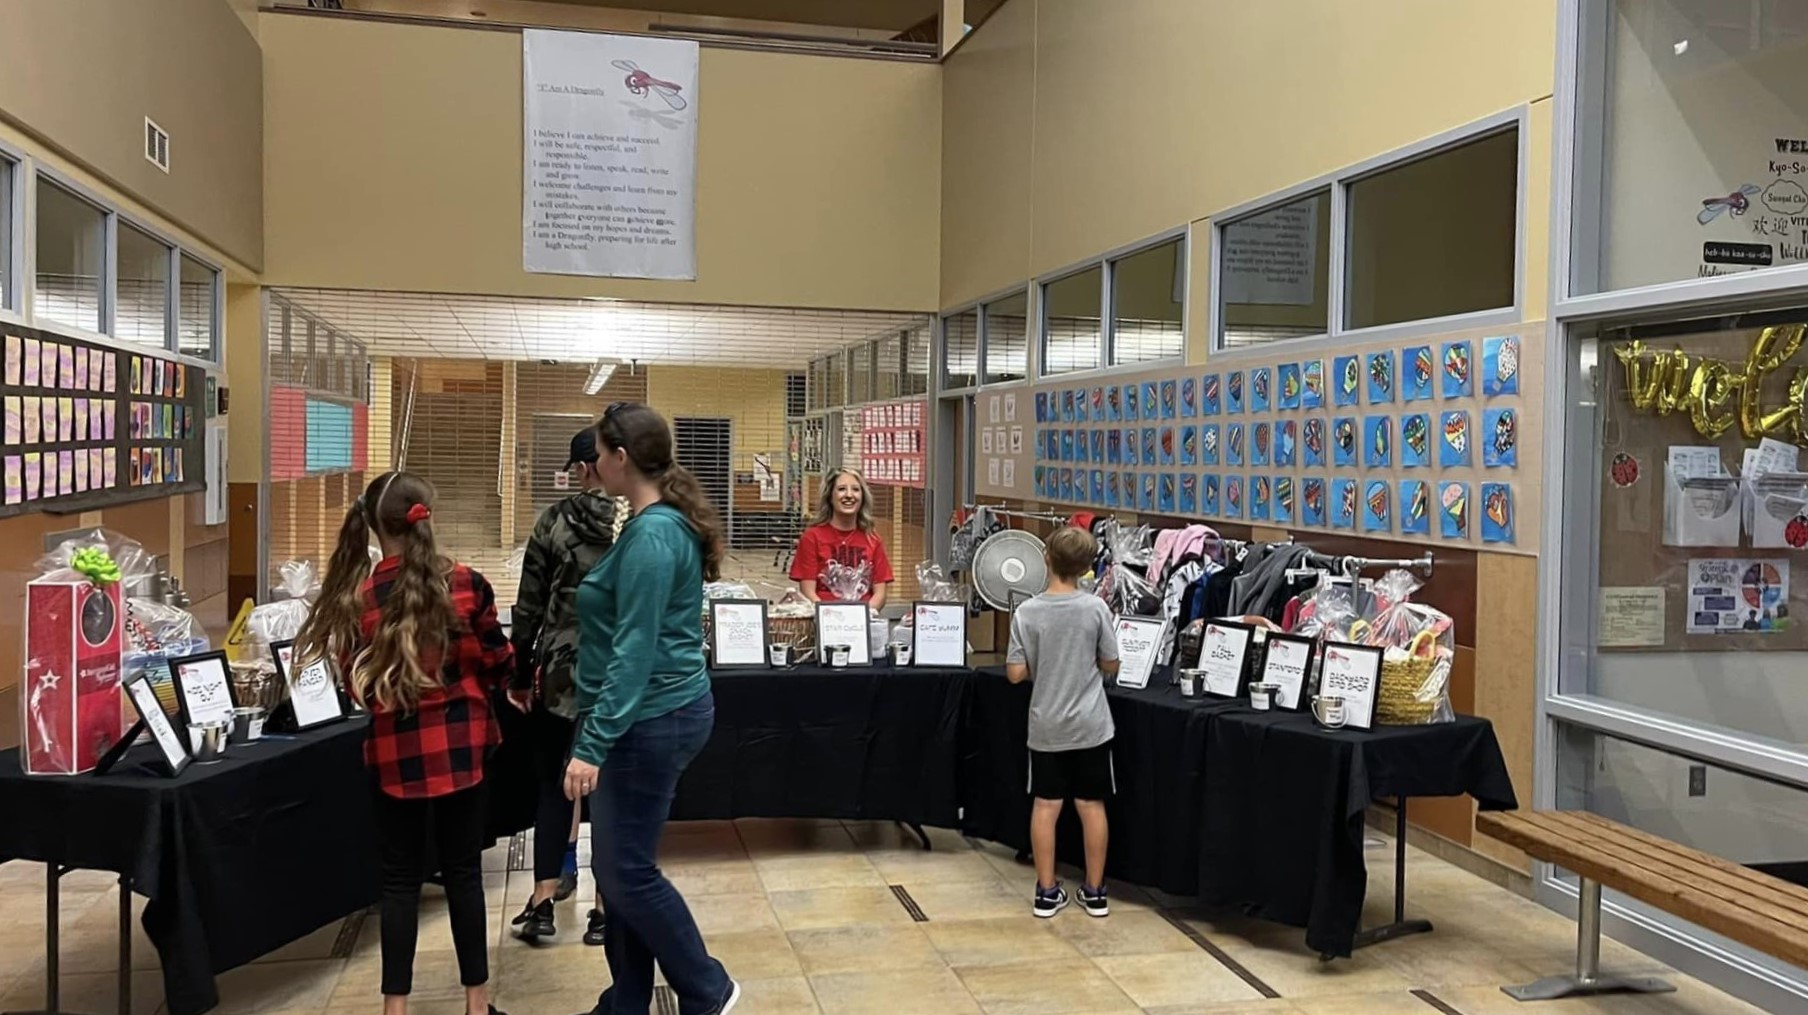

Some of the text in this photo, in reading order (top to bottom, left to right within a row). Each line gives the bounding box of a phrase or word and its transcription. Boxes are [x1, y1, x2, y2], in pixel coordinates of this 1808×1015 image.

[539, 130, 565, 139] believe
[587, 133, 614, 142] achieve
[552, 161, 571, 170] ready
[539, 181, 571, 189] welcome
[573, 182, 611, 192] challenges
[613, 184, 626, 192] and
[628, 185, 645, 193] learn
[648, 187, 664, 195] from
[666, 189, 677, 197] my
[555, 202, 594, 211] collaborate
[614, 205, 636, 213] others
[638, 206, 666, 215] because
[546, 212, 575, 221] together
[578, 214, 610, 223] everyone
[627, 216, 654, 225] achieve
[1790, 216, 1808, 226] VIT
[551, 221, 580, 230] focused
[593, 225, 604, 233] my
[606, 224, 627, 233] hopes
[546, 242, 561, 250] high
[598, 235, 632, 244] preparing
[634, 236, 645, 244] for
[647, 236, 658, 245] life
[660, 238, 676, 246] after
